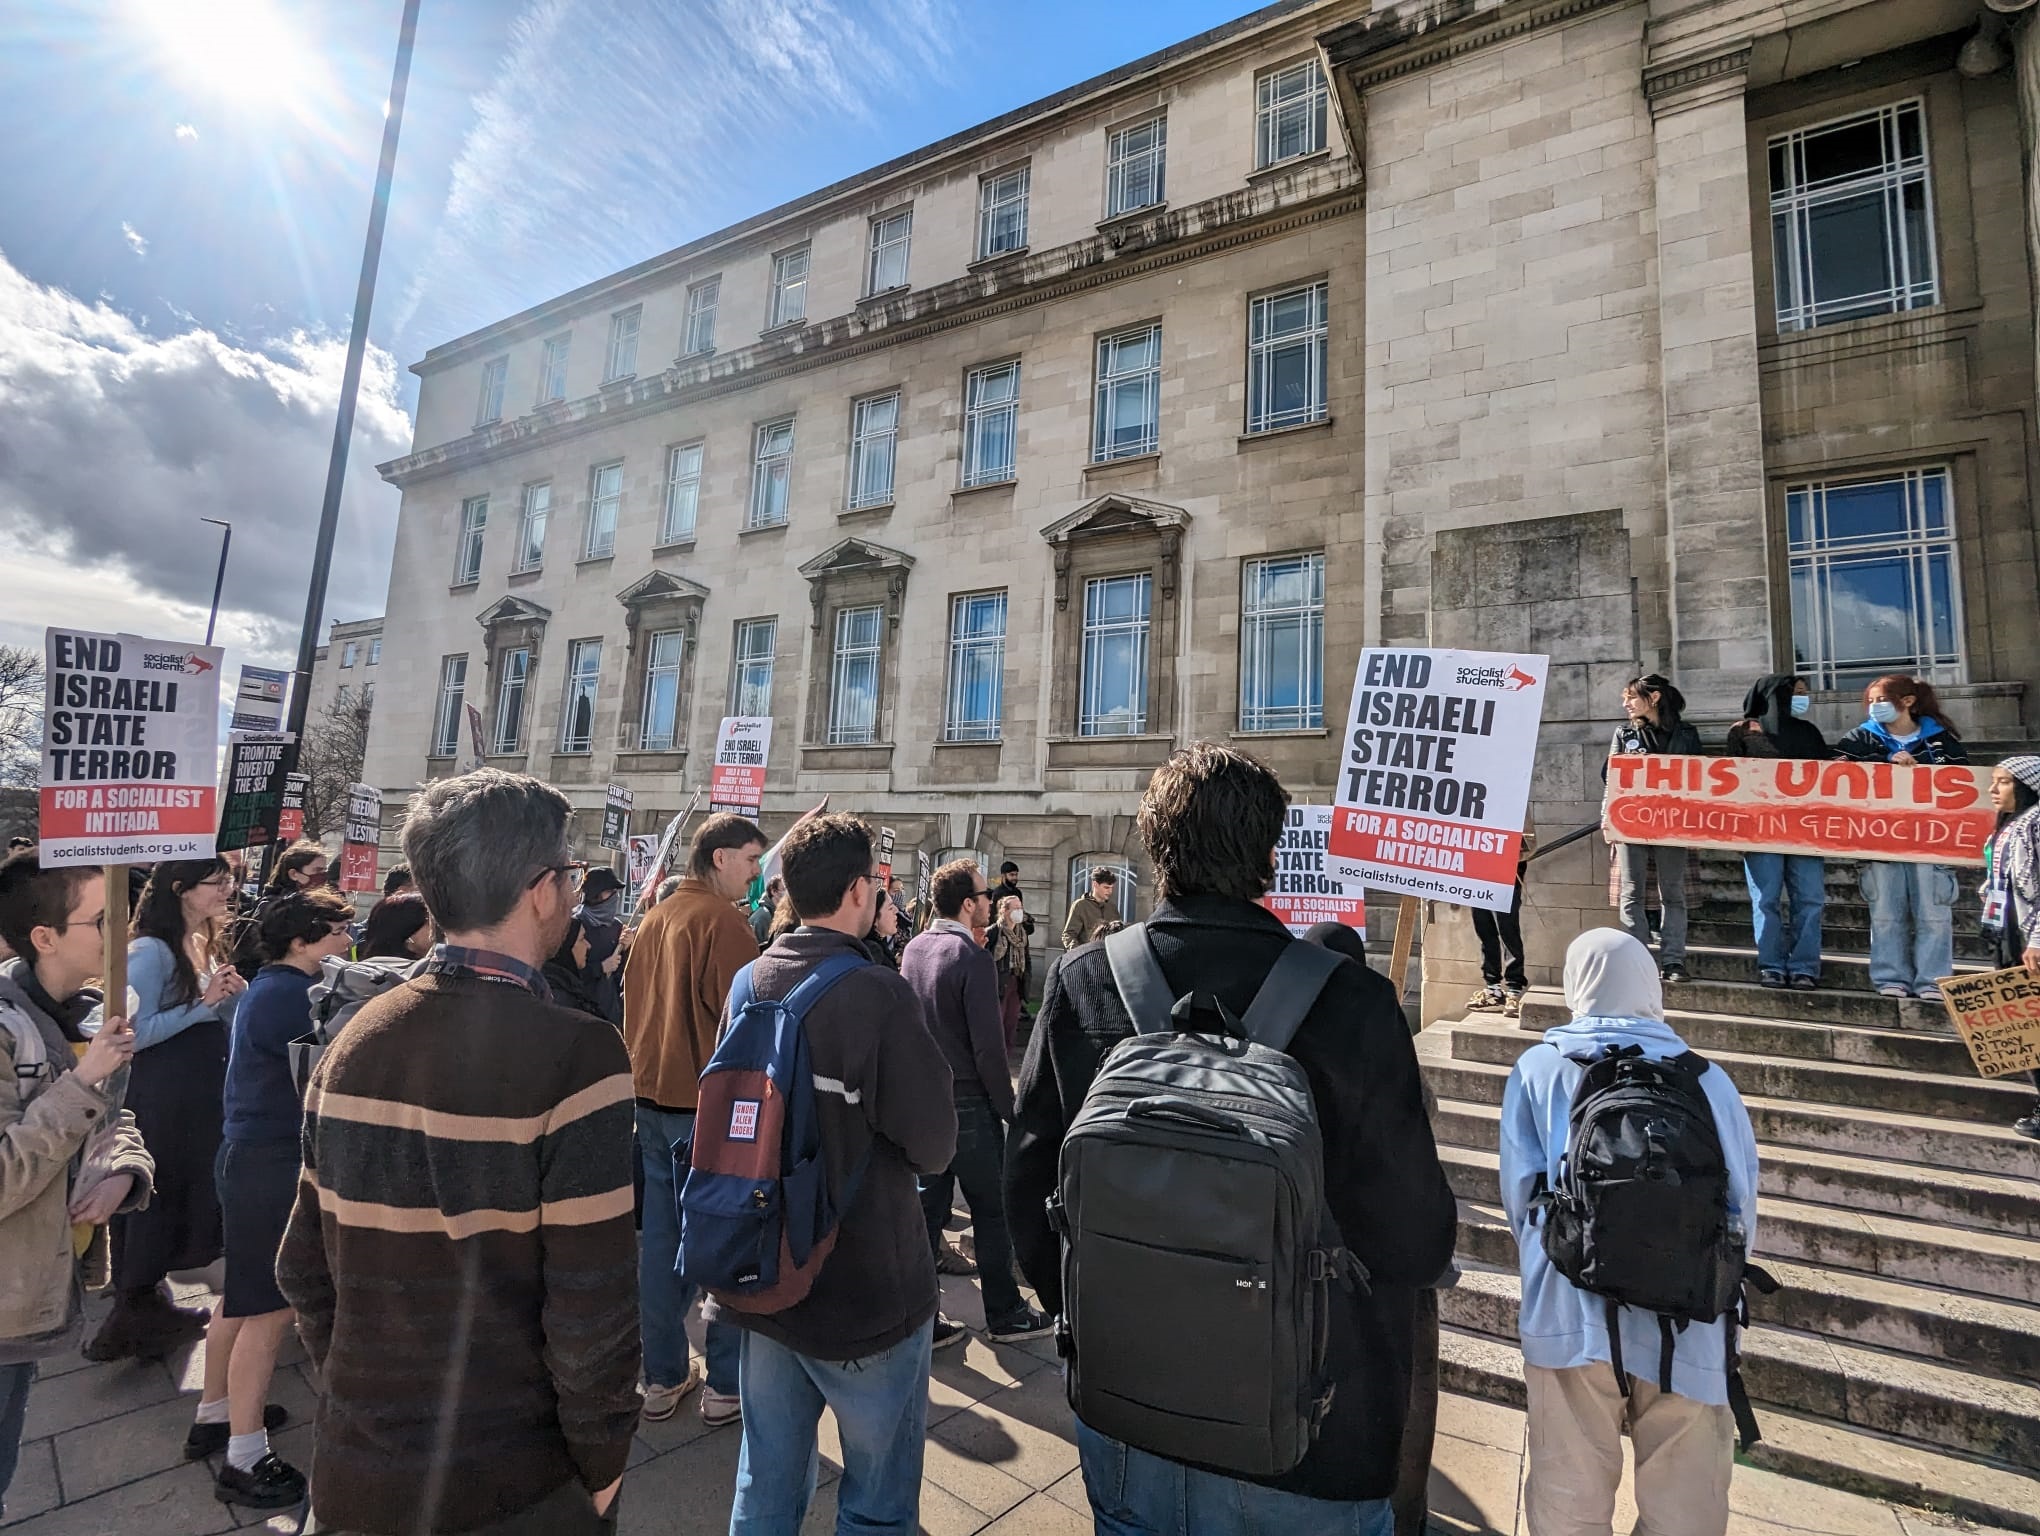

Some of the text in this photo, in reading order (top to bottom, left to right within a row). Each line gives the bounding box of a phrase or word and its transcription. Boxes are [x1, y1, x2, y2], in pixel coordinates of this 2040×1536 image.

[55, 634, 122, 673] END
[143, 652, 185, 664] socialist
[143, 661, 185, 672] students
[1364, 654, 1432, 689] END
[1457, 666, 1504, 678] socialist
[1455, 675, 1505, 687] students
[54, 673, 178, 712] ISRAELI
[1357, 691, 1496, 736] ISRAELI
[52, 711, 146, 746] STATE
[239, 746, 283, 760] FROM THE
[724, 740, 761, 752] END ISRAELI
[1351, 729, 1457, 773] STATE
[50, 749, 177, 781] TERROR
[720, 752, 763, 766] STATE TERROR
[237, 761, 275, 777] RIVER TO
[235, 777, 267, 793] THE SEA
[608, 786, 623, 798] STOP
[1611, 757, 1740, 796] THIS
[1912, 766, 1979, 810] IS
[55, 787, 204, 809] FOR A SOCIALIST
[1347, 767, 1487, 820] TERROR
[282, 797, 303, 808] STINE
[350, 798, 380, 819] FREEDOM
[85, 811, 160, 833] INTIFADA
[1619, 803, 1977, 848] COMPLICIT IN GENOCIDE
[345, 823, 379, 844] PALESTINE
[1346, 812, 1508, 855] FOR A SOCIALIST
[53, 841, 197, 858] socialiststudents.org.uk
[1375, 840, 1465, 873] INTIFADA
[1339, 865, 1494, 902] socialiststudents.org.uk
[1271, 898, 1358, 912] FOR A SOCIALIST
[1995, 972, 2015, 985] OF
[1953, 981, 2040, 1013] BEST DES
[1989, 1036, 2023, 1050] TORY
[1994, 1043, 2035, 1060] TWAT
[735, 1104, 756, 1114] IGNORE
[735, 1115, 752, 1125] ALIEN
[731, 1126, 754, 1135] ORDERS
[738, 1274, 758, 1283] adidas
